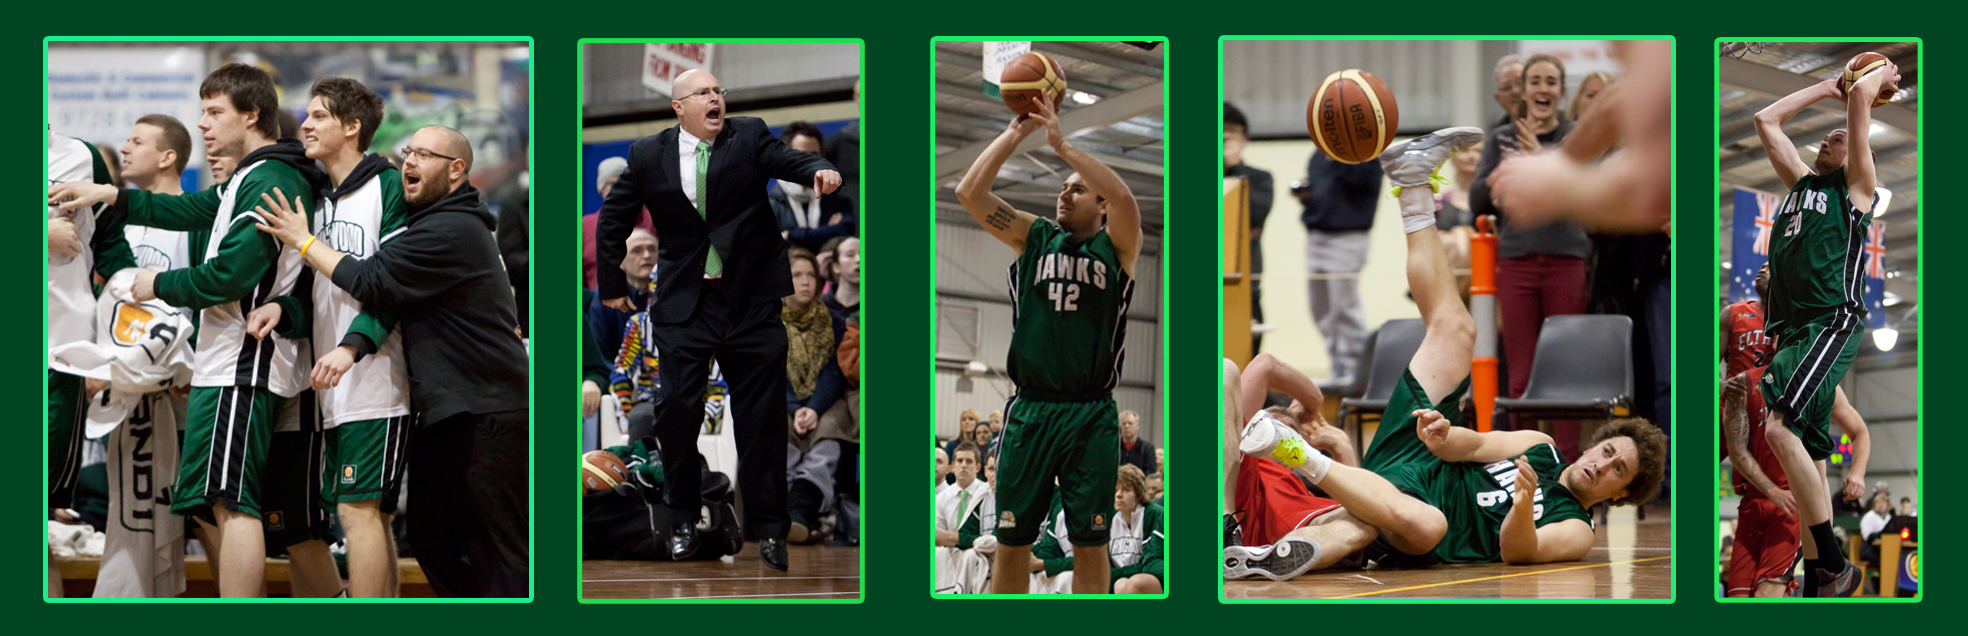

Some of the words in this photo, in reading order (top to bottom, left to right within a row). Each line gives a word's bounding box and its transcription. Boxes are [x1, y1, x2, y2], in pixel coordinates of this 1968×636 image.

[1323, 98, 1348, 156] molten
[1349, 103, 1368, 133] FIBA
[1784, 211, 1803, 237] 20
[1048, 281, 1081, 312] 42
[1476, 489, 1509, 507] 6
